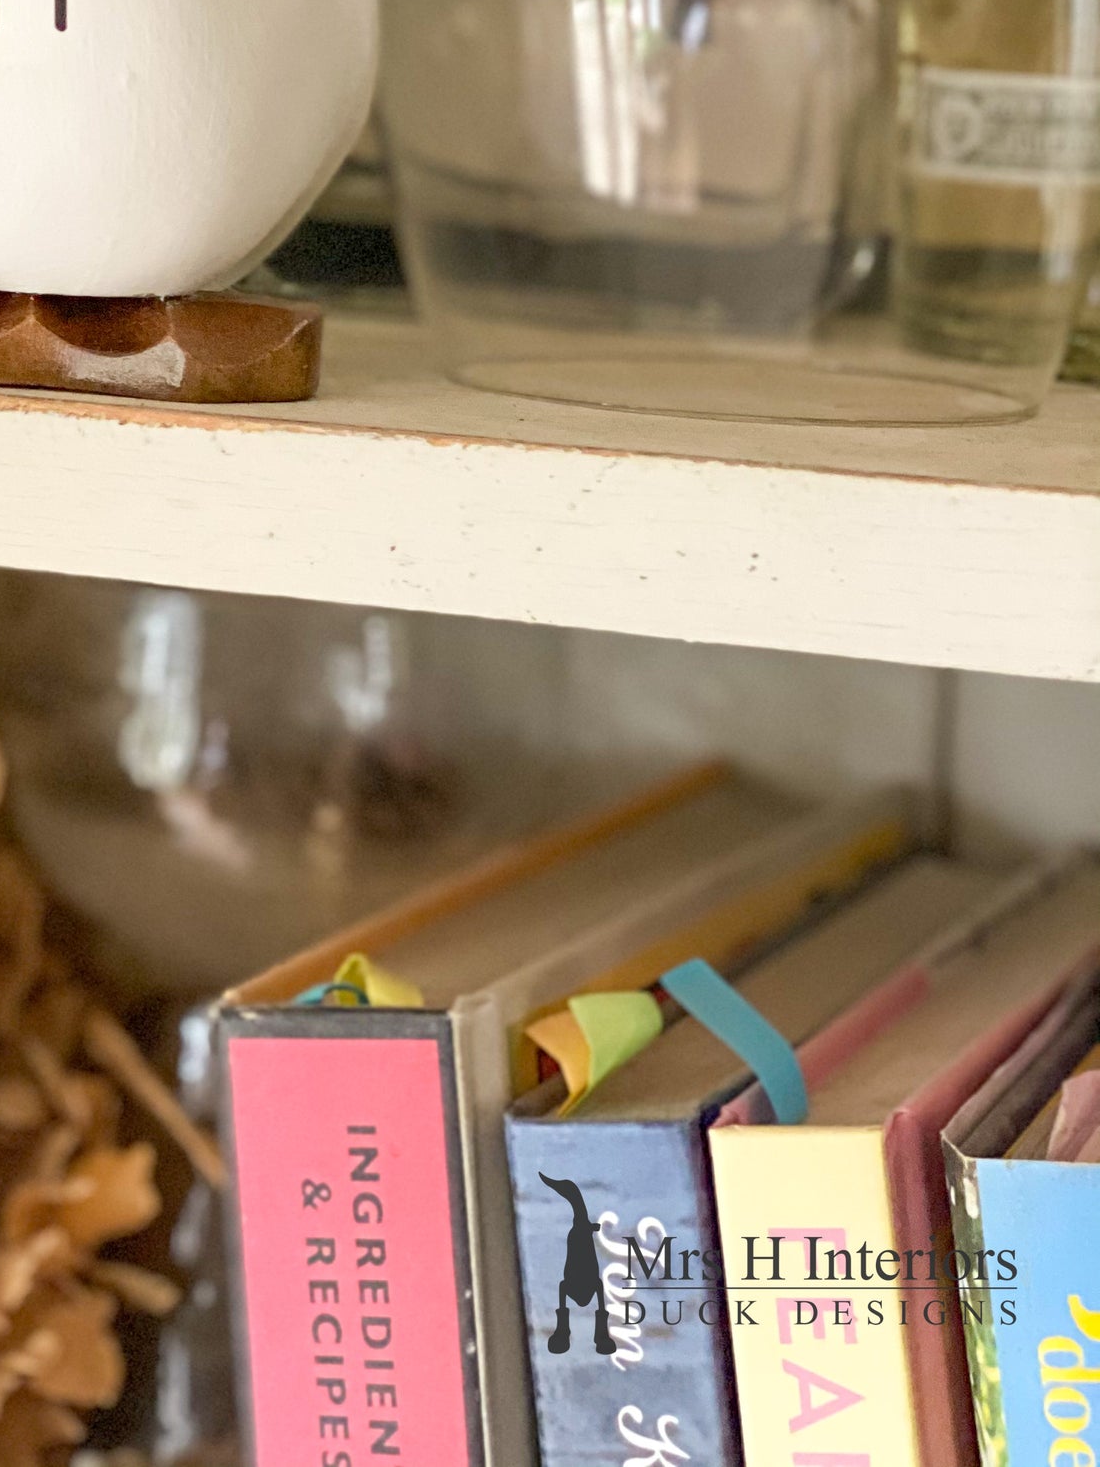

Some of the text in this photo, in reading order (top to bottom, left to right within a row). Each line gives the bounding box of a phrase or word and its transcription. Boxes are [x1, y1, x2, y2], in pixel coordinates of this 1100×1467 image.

[302, 1178, 332, 1211] &
[597, 1211, 669, 1372] Tom
[768, 1227, 872, 1467] FEA
